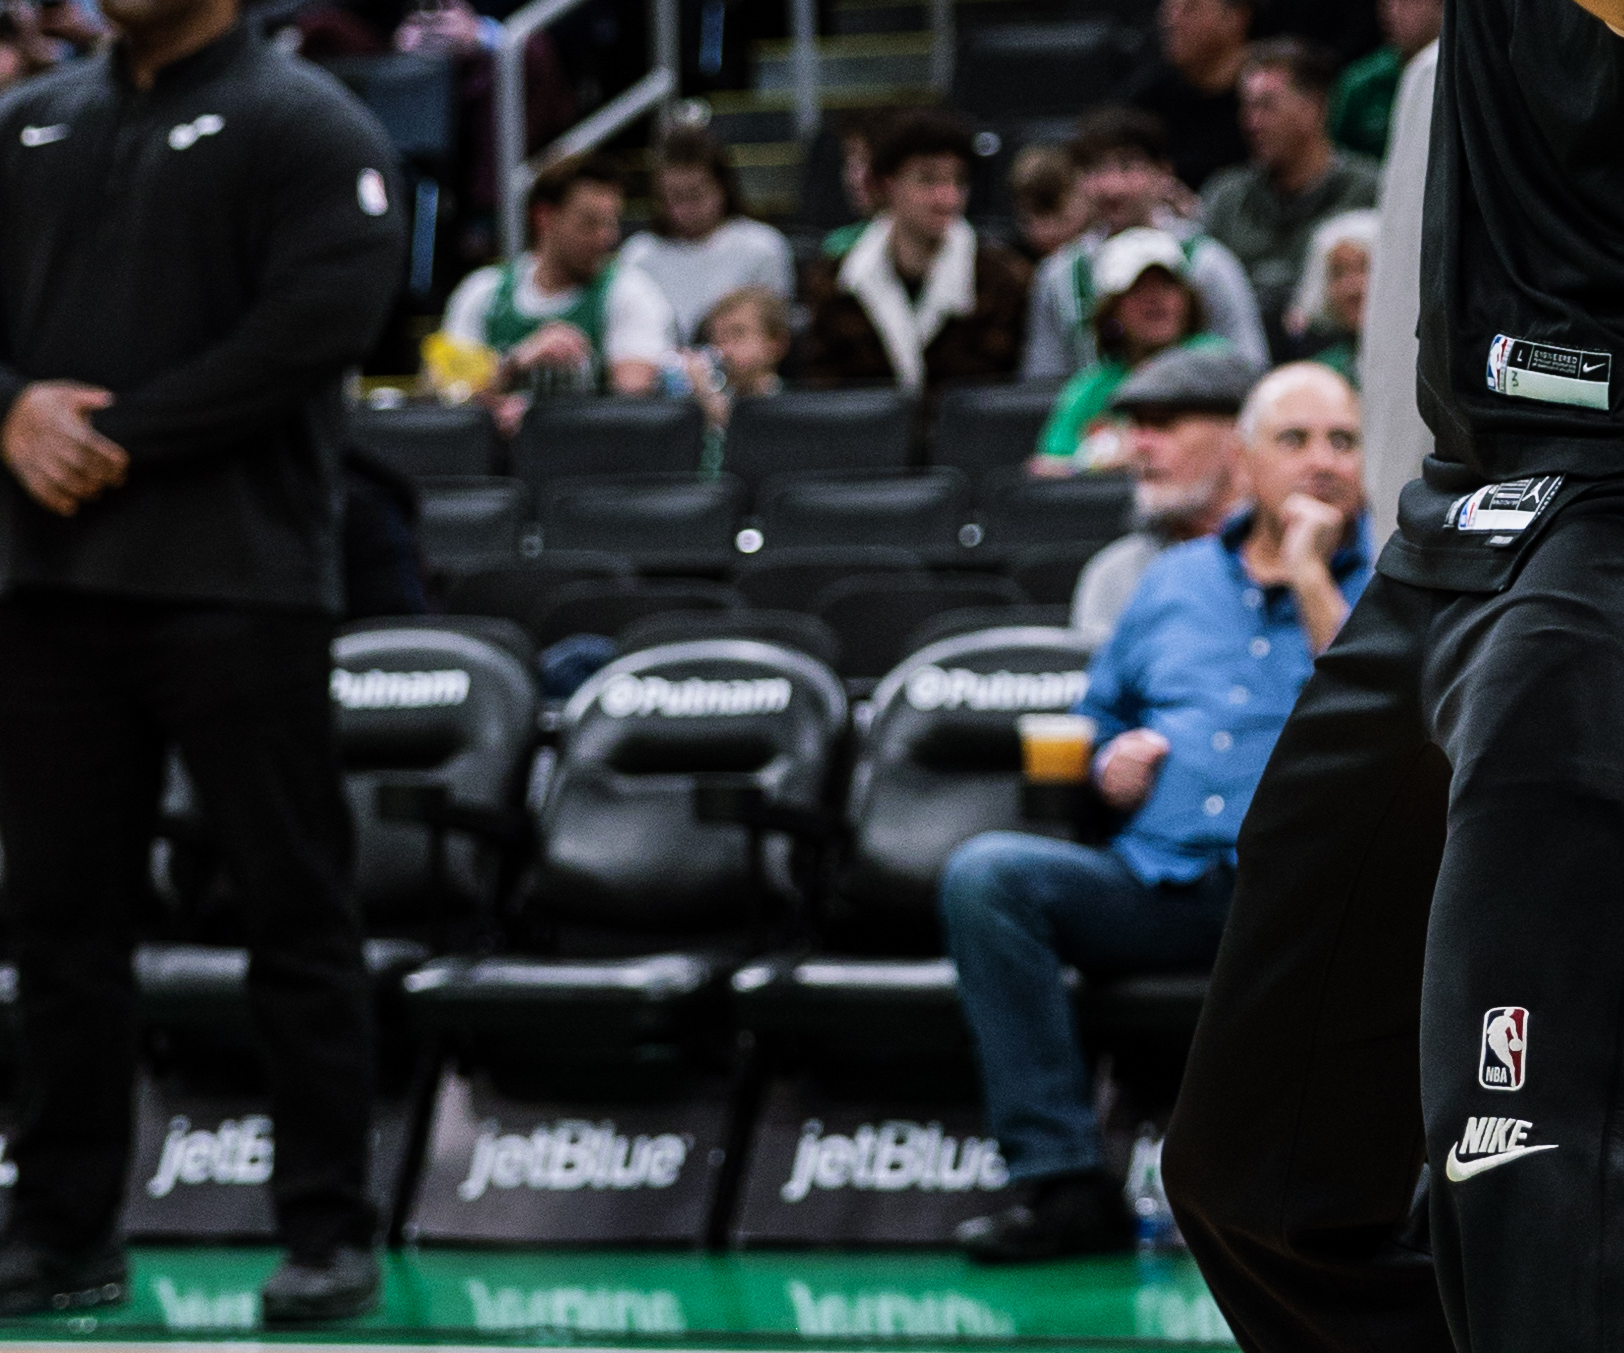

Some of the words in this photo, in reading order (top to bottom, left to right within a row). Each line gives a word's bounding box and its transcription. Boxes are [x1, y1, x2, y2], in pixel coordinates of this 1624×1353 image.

[638, 675, 792, 717] Putnam
[1485, 1065, 1508, 1084] NBA
[1458, 1116, 1533, 1155] NIKE
[457, 1116, 690, 1201] jetBlue
